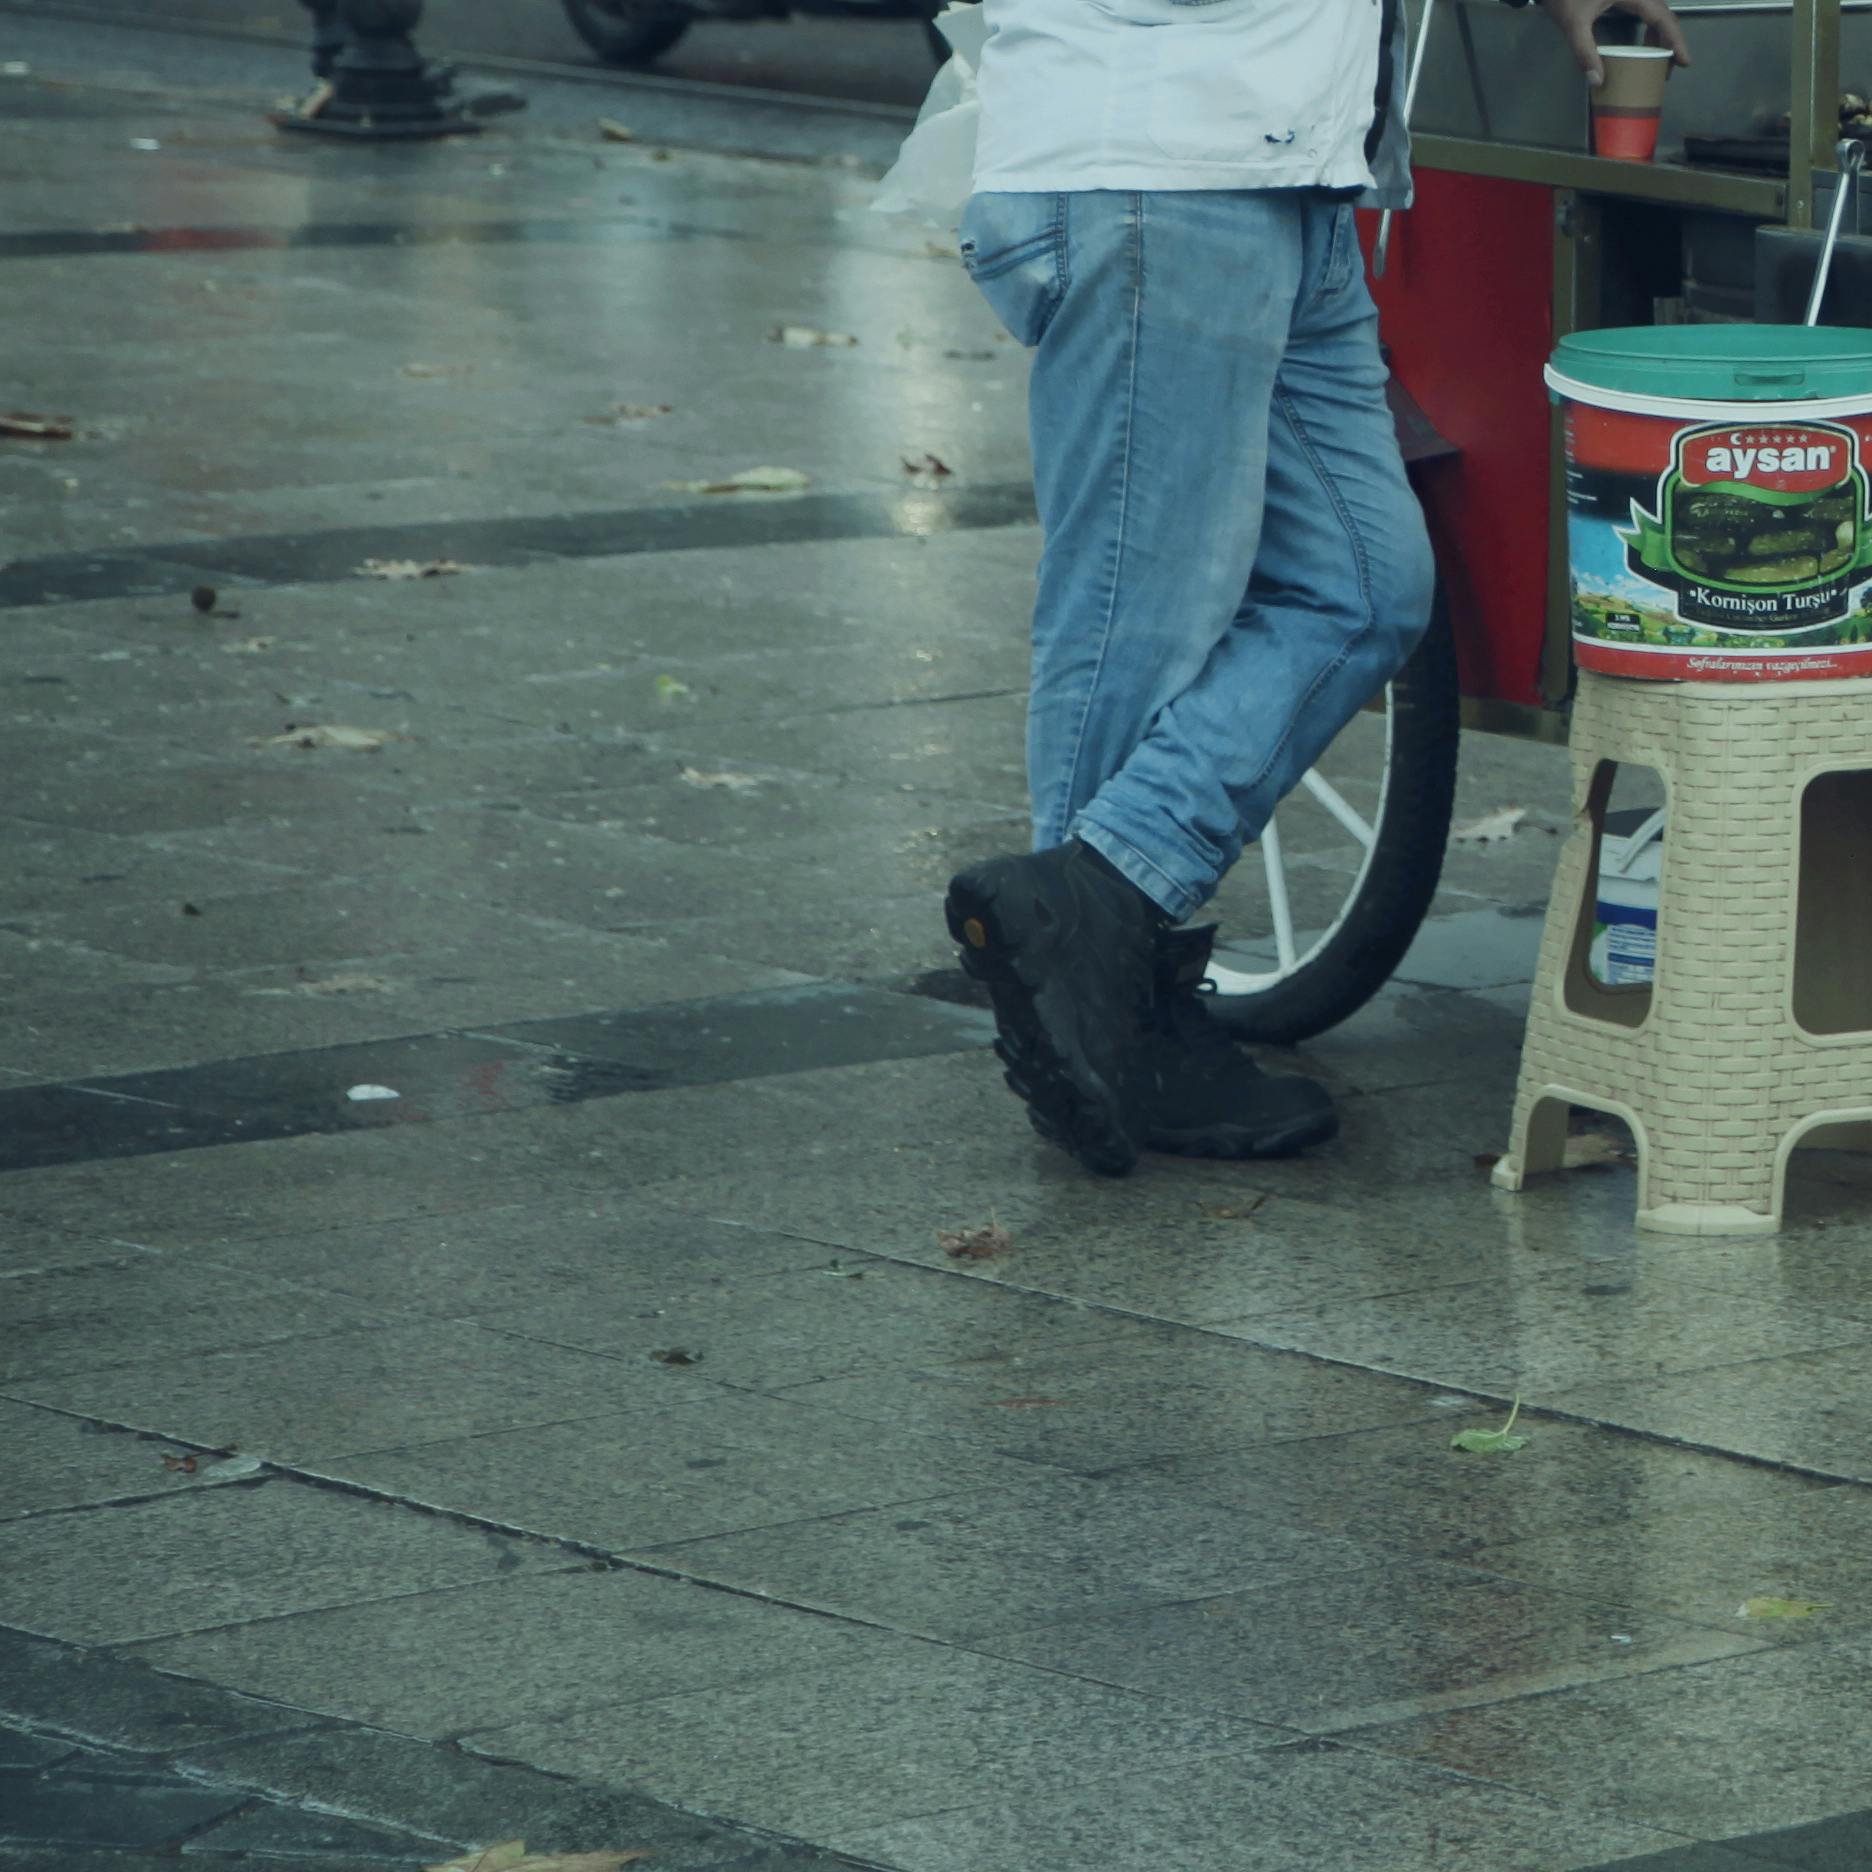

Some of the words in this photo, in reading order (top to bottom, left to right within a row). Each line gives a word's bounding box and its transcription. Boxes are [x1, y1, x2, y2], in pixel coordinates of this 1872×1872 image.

[1705, 445, 1830, 479] aysan
[1697, 587, 1779, 614] Kornişon
[1781, 586, 1831, 611] Turşu
